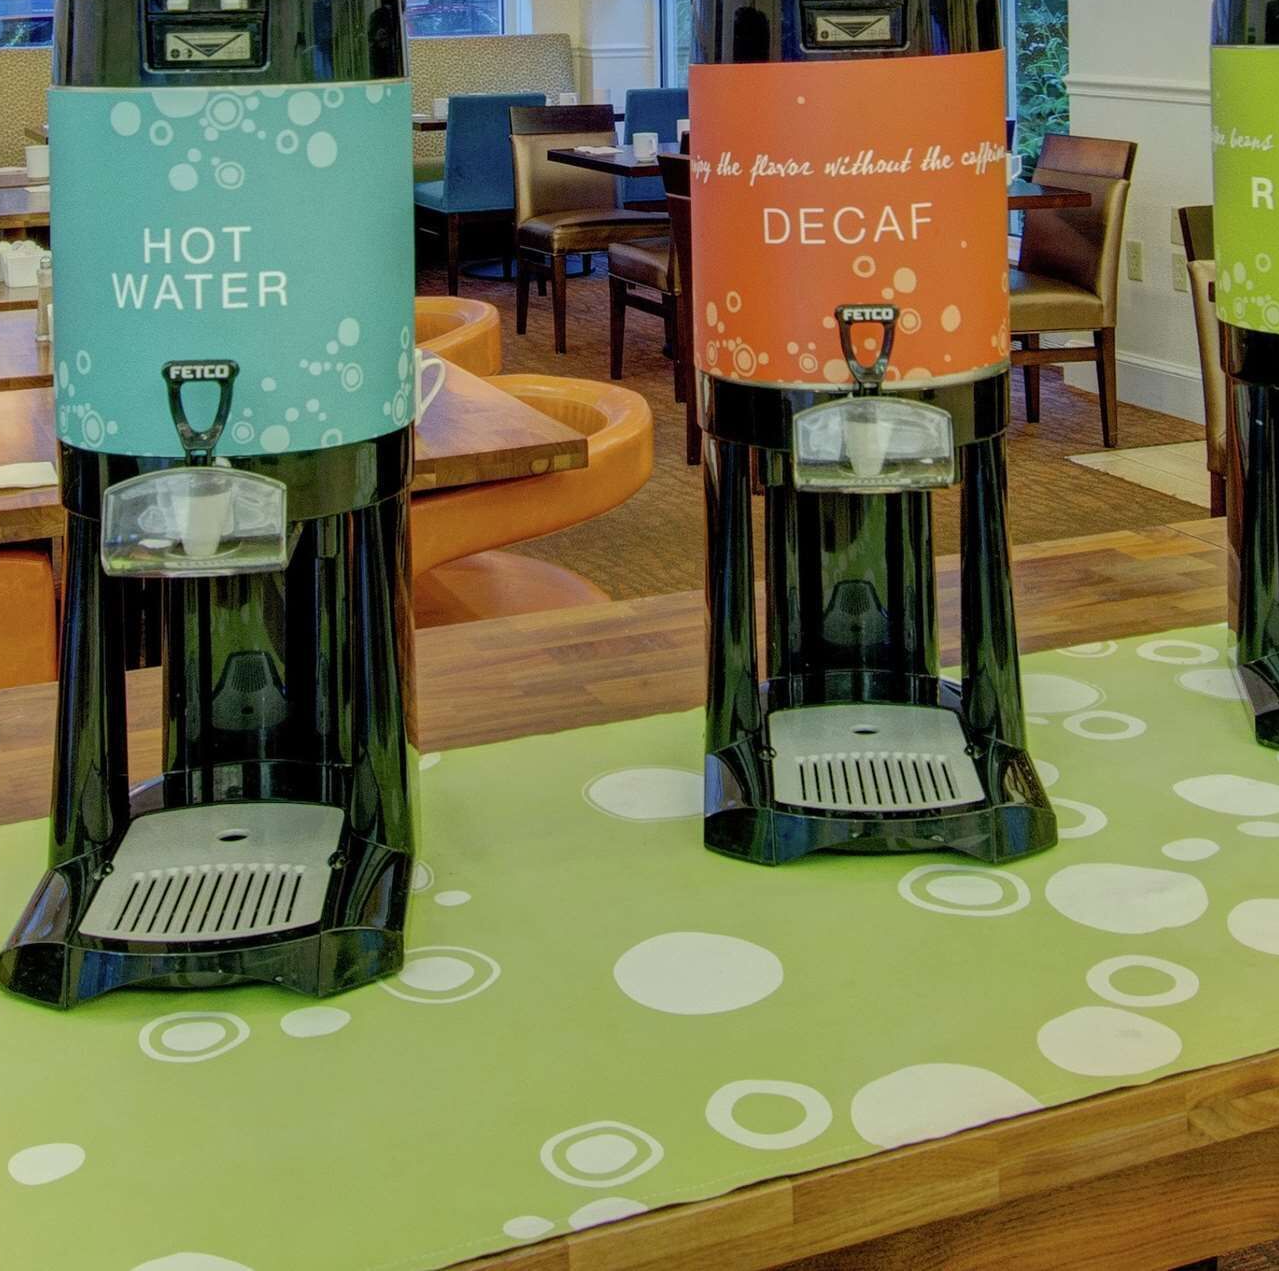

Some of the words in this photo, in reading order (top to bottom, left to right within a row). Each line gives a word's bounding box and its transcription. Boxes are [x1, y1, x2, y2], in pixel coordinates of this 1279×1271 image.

[717, 151, 742, 176] the
[749, 154, 814, 187] flavor
[824, 148, 913, 177] without
[921, 145, 953, 171] the
[763, 202, 933, 245] DECAF
[143, 226, 252, 264] HOT
[111, 270, 288, 310] WATER
[843, 308, 894, 321] FETCO
[169, 365, 229, 379] FETCO
